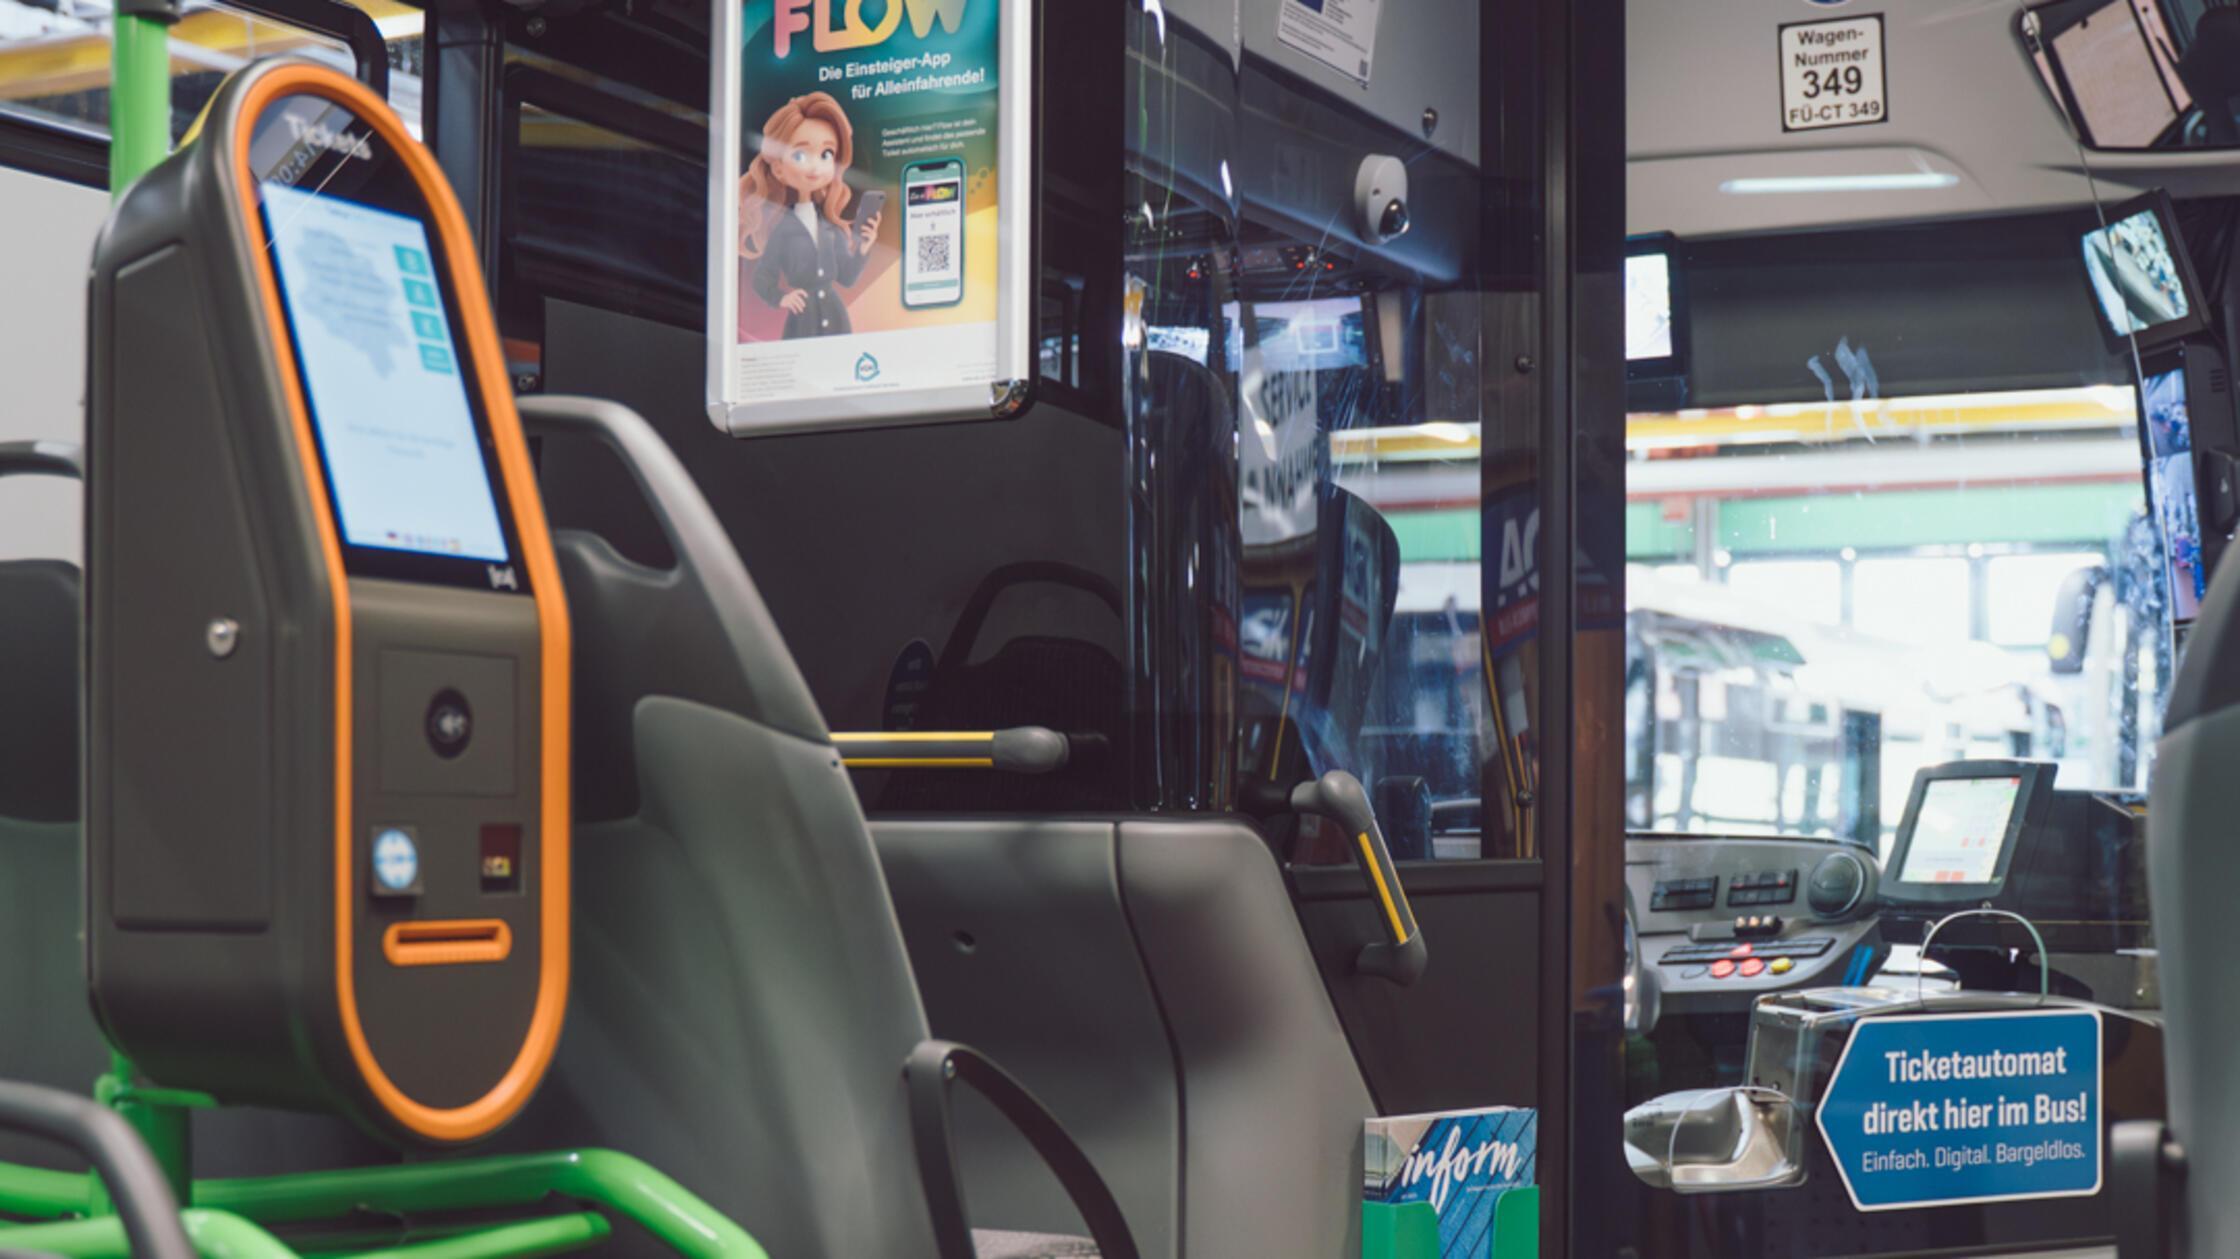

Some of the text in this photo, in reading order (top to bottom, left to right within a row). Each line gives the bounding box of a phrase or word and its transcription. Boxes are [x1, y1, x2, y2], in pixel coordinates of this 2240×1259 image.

[773, 0, 968, 58] FLOW
[1797, 28, 1864, 46] Wagen-
[819, 51, 951, 82] Die Einsteiger-App
[1794, 48, 1869, 67] Nummer
[851, 68, 985, 100] für Alleinfahrende!
[1803, 65, 1862, 99] 349
[1789, 100, 1880, 123] FÜ-CT 349
[1885, 1046, 2067, 1083] Ticketautomat
[1863, 1092, 2087, 1135] direkt hier im Bus!
[1401, 1124, 1521, 1216] inform
[1862, 1140, 2085, 1173] Einfach. Digital. Bargeldlos.
